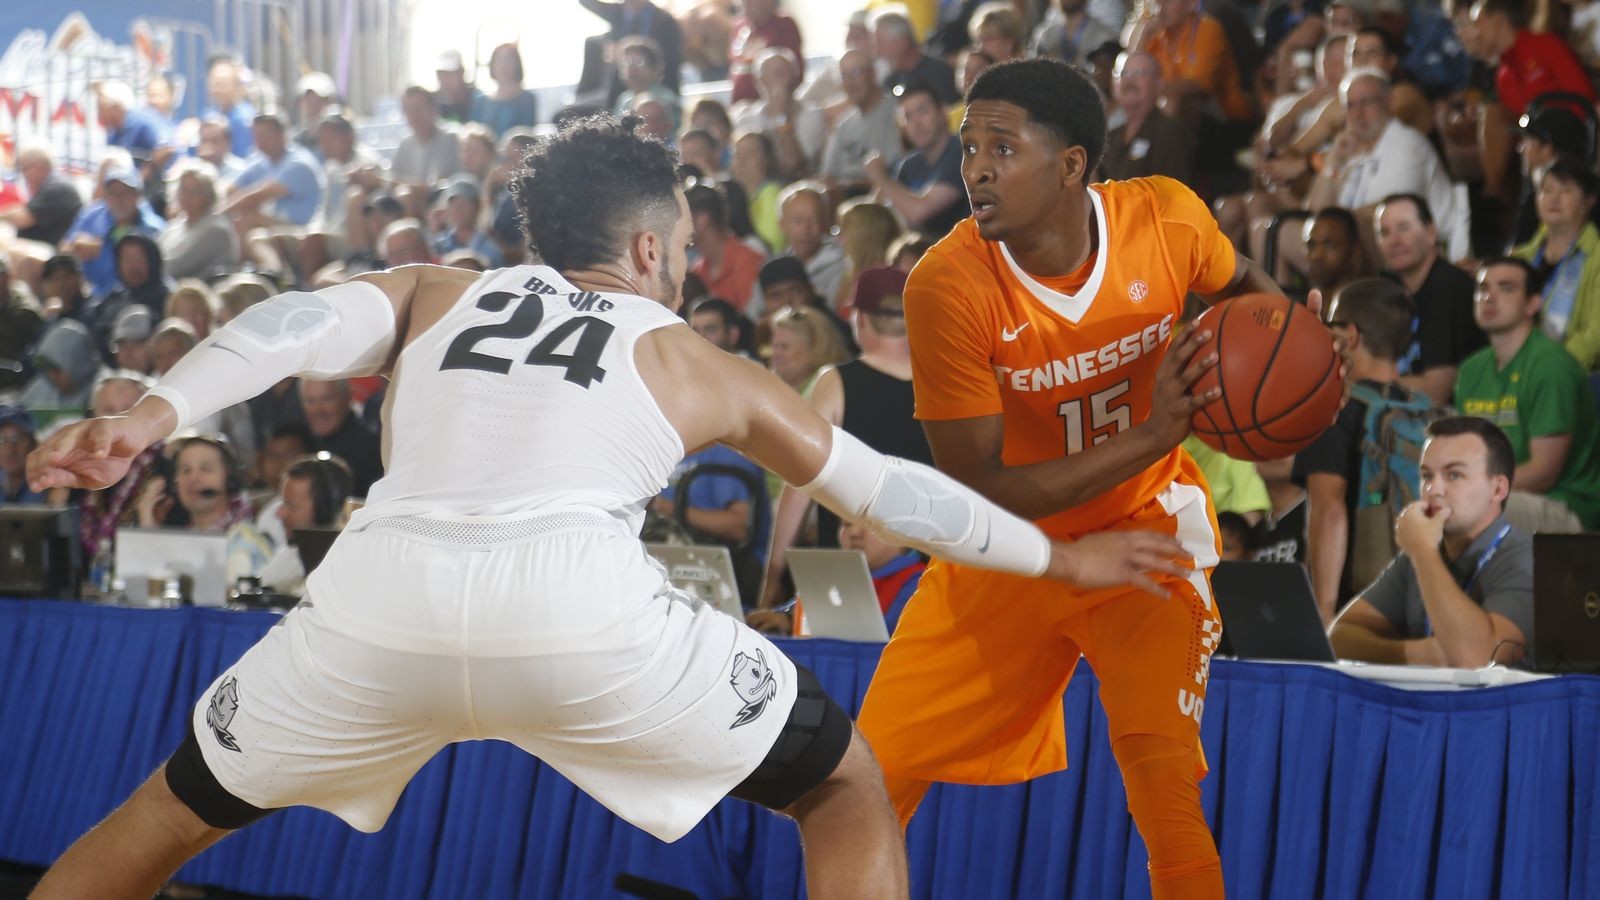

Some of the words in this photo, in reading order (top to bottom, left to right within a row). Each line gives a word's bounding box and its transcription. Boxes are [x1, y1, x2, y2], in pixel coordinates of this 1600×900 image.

[523, 276, 614, 312] BROKS
[1130, 282, 1147, 300] SEC
[439, 291, 616, 390] 24
[992, 313, 1174, 391] TENNESSEE
[1057, 378, 1131, 456] 15
[1178, 688, 1204, 727] VO
